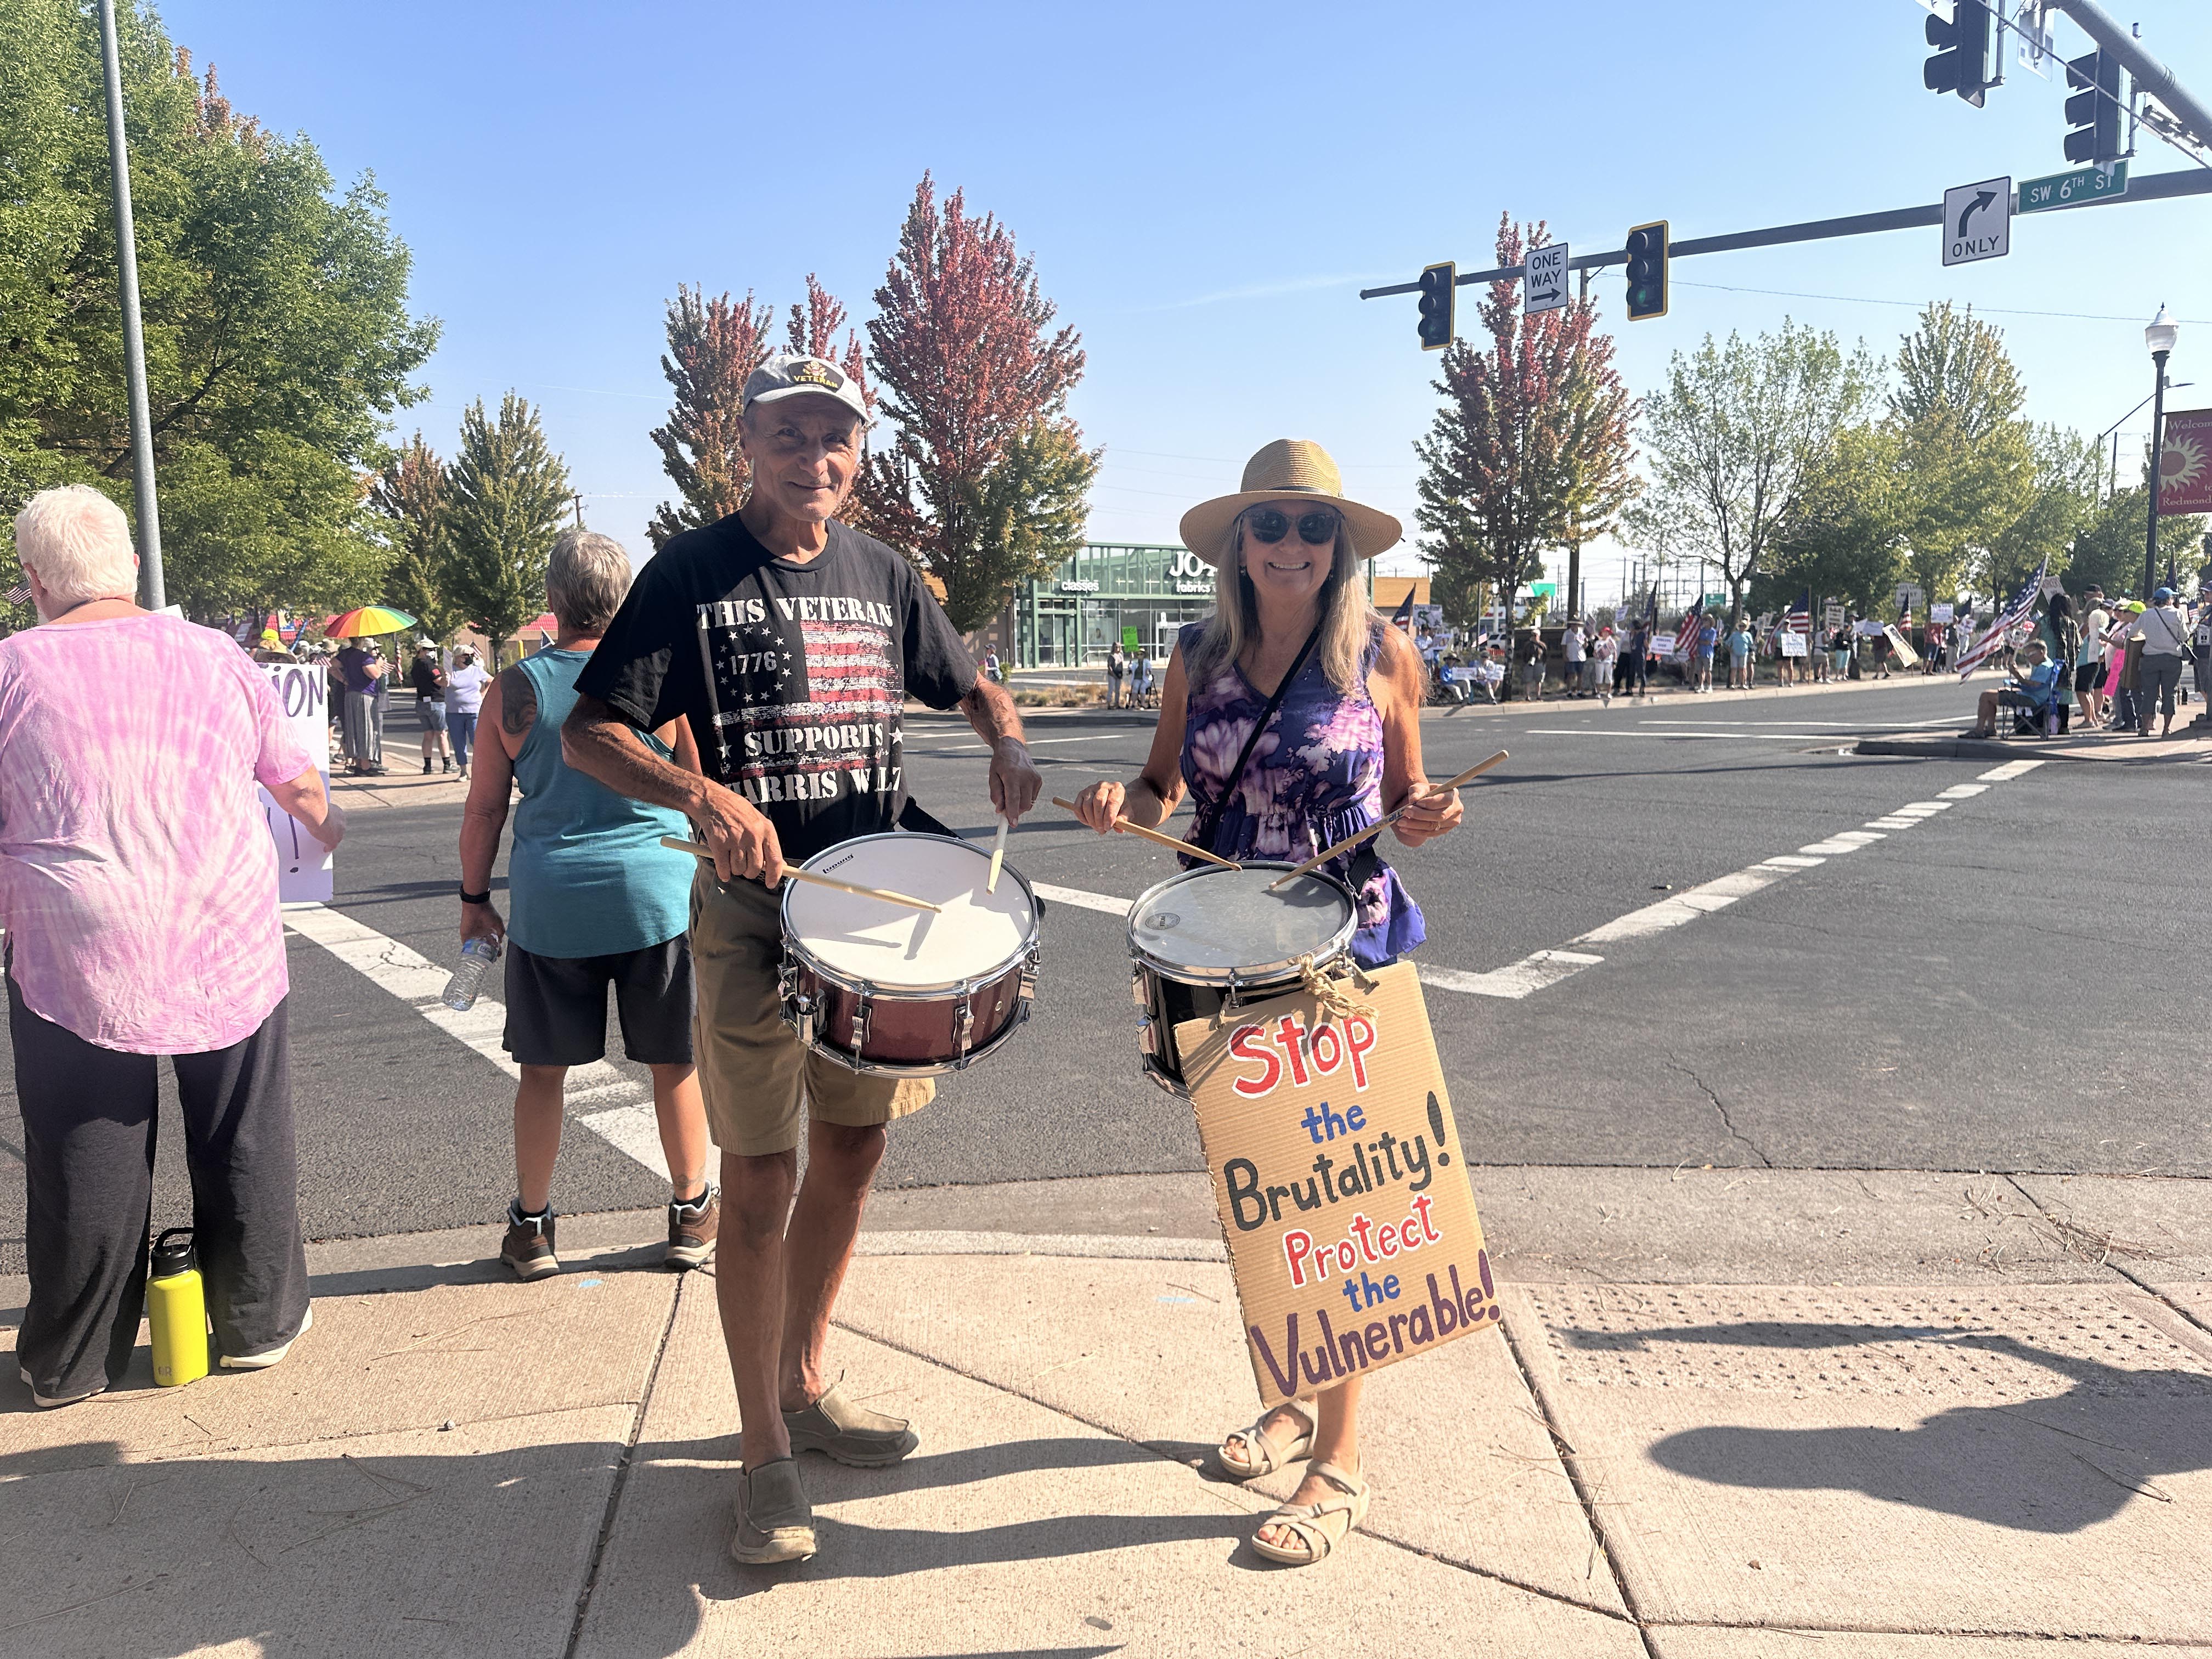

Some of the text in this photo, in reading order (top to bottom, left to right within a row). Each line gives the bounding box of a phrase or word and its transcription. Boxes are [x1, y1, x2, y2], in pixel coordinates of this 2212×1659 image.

[2030, 174, 2111, 202] SW 6TH ST
[1532, 251, 1561, 270] ONE
[1953, 236, 2000, 258] ONLY
[1531, 269, 1562, 289] WAY
[794, 375, 838, 388] VETERAN
[2163, 495, 2211, 506] Redmond
[1062, 580, 1099, 592] classes
[1176, 580, 1211, 593] fabrics
[697, 596, 894, 629] THIS VETERAN
[729, 651, 777, 675] 1776
[744, 723, 883, 757] SUPPORTS
[1227, 1013, 1379, 1098] Stop
[1301, 1102, 1367, 1145] the
[1223, 1091, 1451, 1232] Brutality!
[1283, 1192, 1443, 1290] Protect
[1342, 1271, 1401, 1313] the
[1250, 1248, 1500, 1398] Vulnerable!
